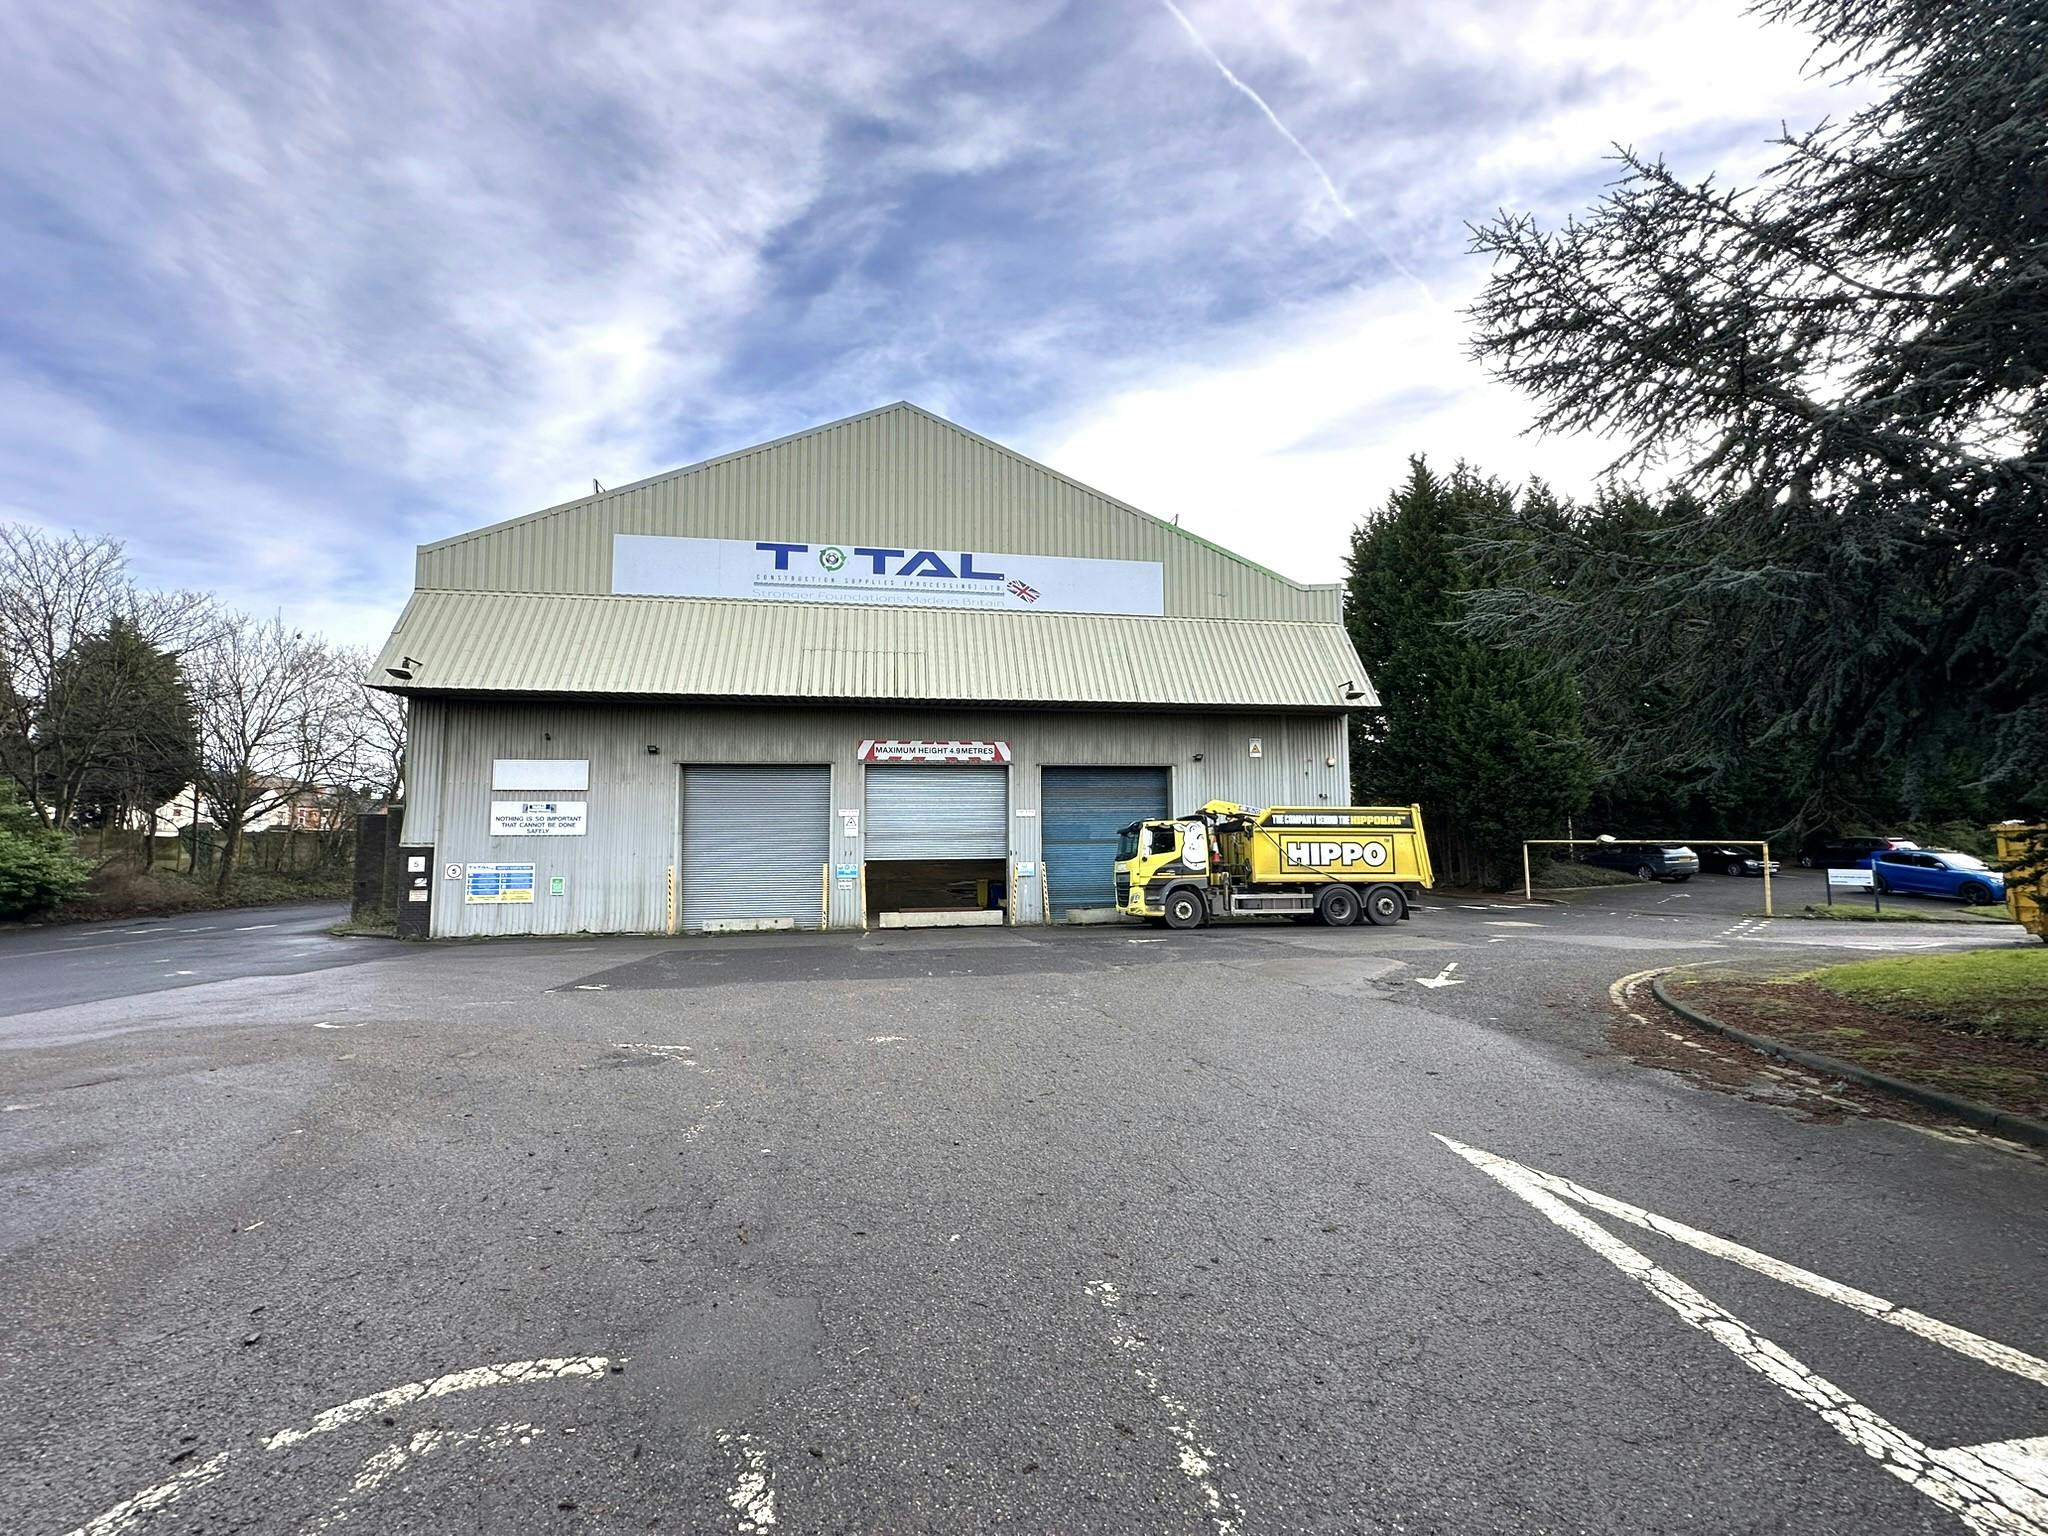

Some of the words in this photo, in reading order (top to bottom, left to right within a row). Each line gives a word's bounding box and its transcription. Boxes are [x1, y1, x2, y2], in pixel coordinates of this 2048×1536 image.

[756, 574, 835, 583] CONSTRUCTION
[845, 577, 894, 586] SUPPLIES
[752, 588, 815, 600] Stronger
[817, 590, 904, 603] Foundations
[906, 595, 944, 605] Made
[947, 597, 959, 605] in
[962, 597, 1005, 607] Britain
[875, 746, 916, 754] MAXIMUM
[918, 747, 947, 755] HEIGHT
[1272, 814, 1284, 824] THE
[1284, 815, 1316, 825] COMPANY
[1339, 815, 1350, 825] THE
[1287, 841, 1387, 867] HIPPO
